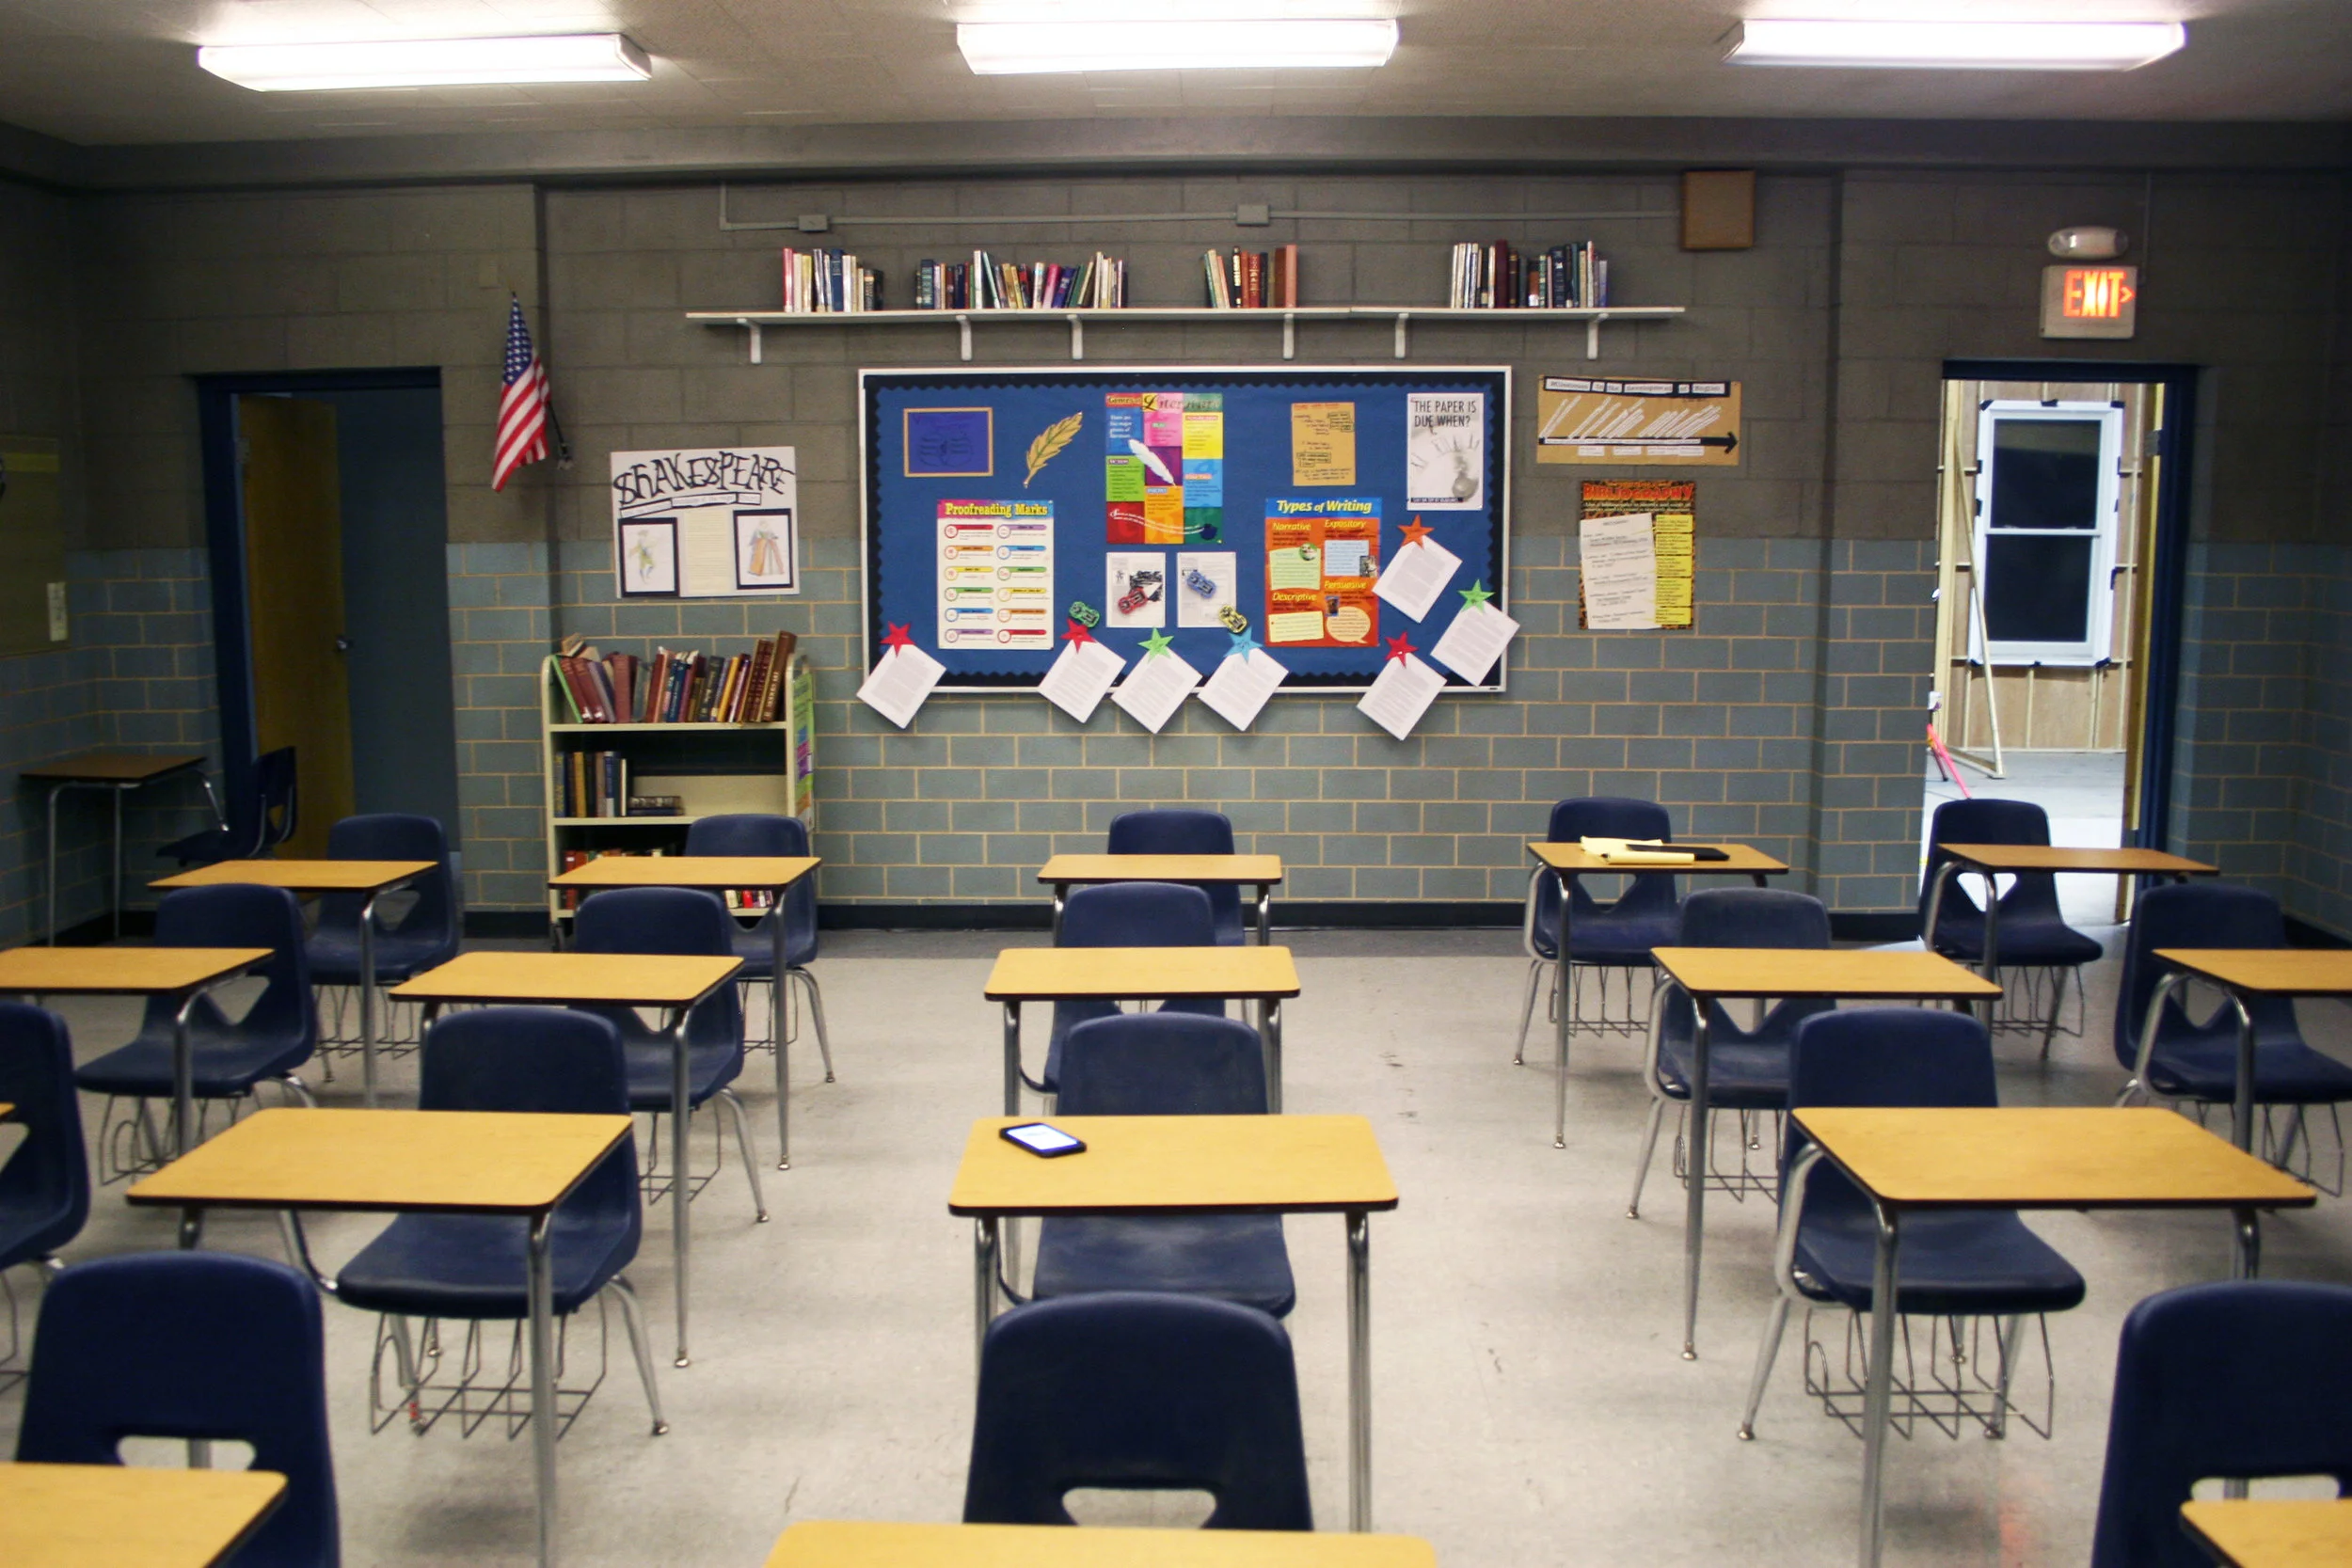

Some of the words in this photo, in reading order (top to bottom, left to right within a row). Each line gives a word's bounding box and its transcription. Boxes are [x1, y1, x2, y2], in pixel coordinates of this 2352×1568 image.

[2063, 270, 2126, 318] EXIT
[1414, 401, 1433, 412] THE
[1435, 401, 1465, 413] PAPER
[1468, 401, 1476, 413] IS
[1414, 415, 1433, 427] DUE
[1437, 415, 1470, 427] WHEN?
[1583, 483, 1693, 500] BIBLIOGRAPHY
[945, 502, 1011, 518] Proofreading
[1015, 503, 1047, 515] Marks
[1277, 499, 1312, 514] Types
[1313, 502, 1325, 513] of
[1327, 499, 1373, 514] Writing
[1272, 522, 1311, 531] Narrative
[1325, 519, 1366, 529] Expository
[1325, 581, 1367, 590] Persuasive
[1272, 593, 1317, 602] Descriptive
